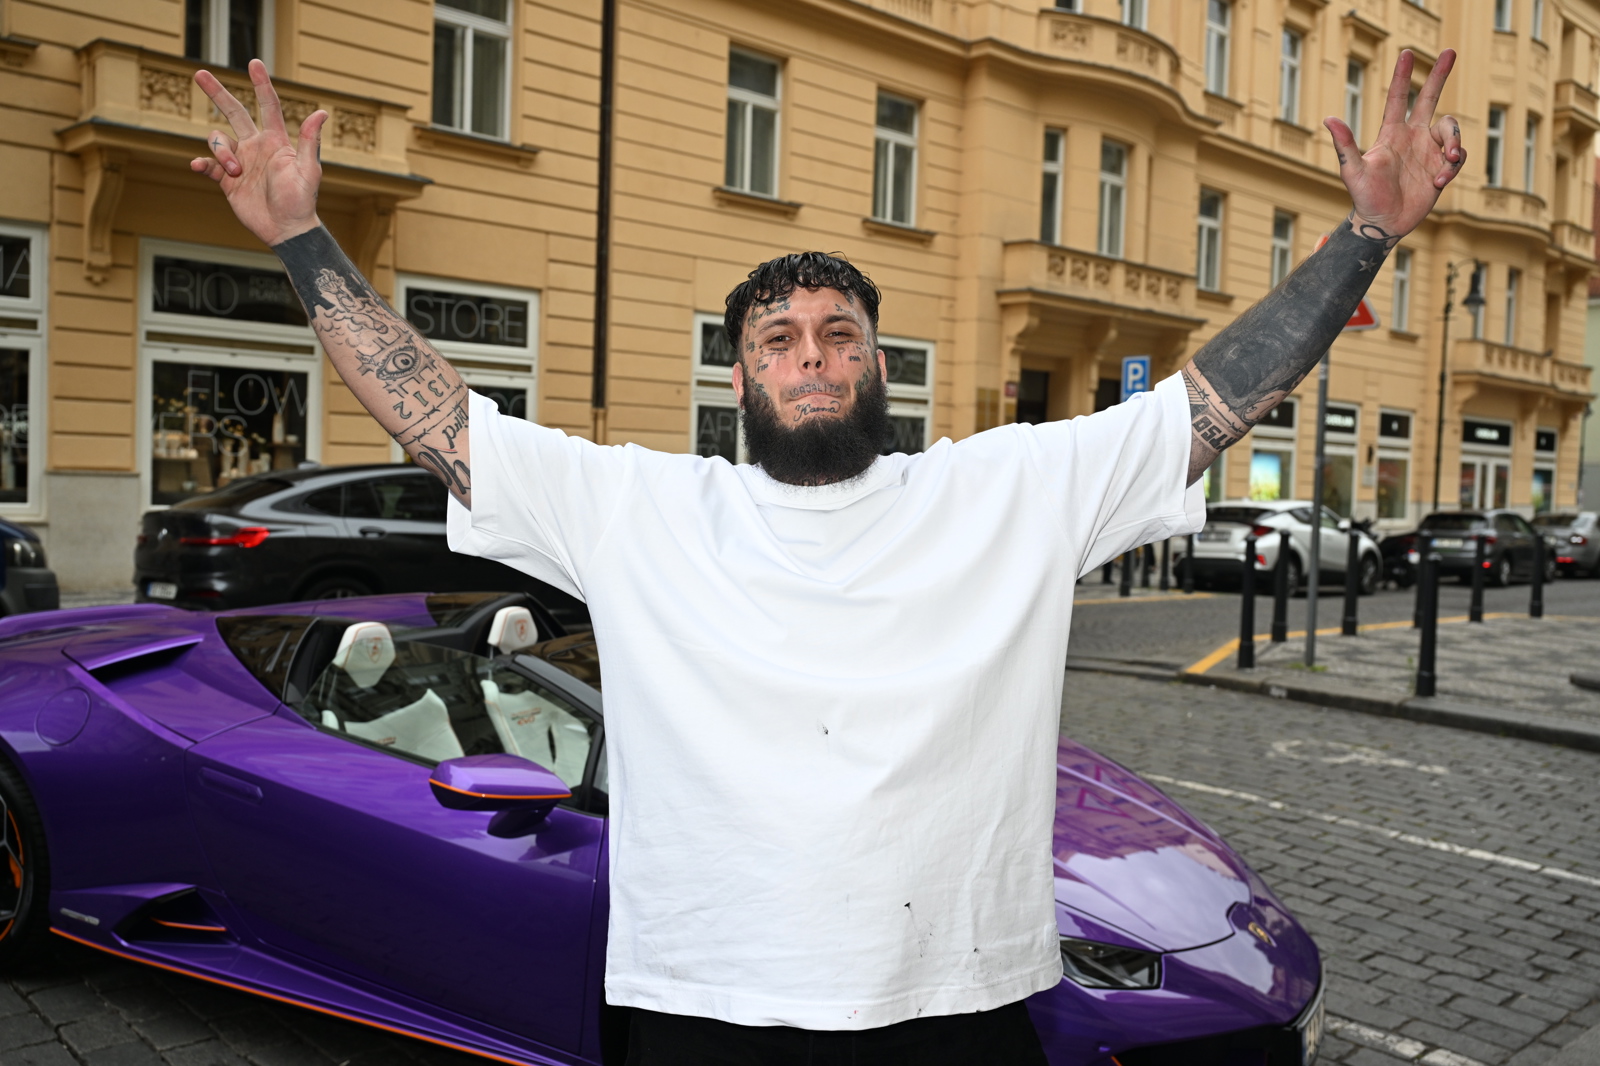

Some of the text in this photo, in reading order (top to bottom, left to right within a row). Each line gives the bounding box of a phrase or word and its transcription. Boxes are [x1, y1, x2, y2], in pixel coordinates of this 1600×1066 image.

[154, 266, 240, 316] RIO
[410, 295, 525, 343] STORE
[187, 369, 307, 417] FLOW
[1127, 362, 1144, 390] P
[153, 412, 249, 457] ERS
